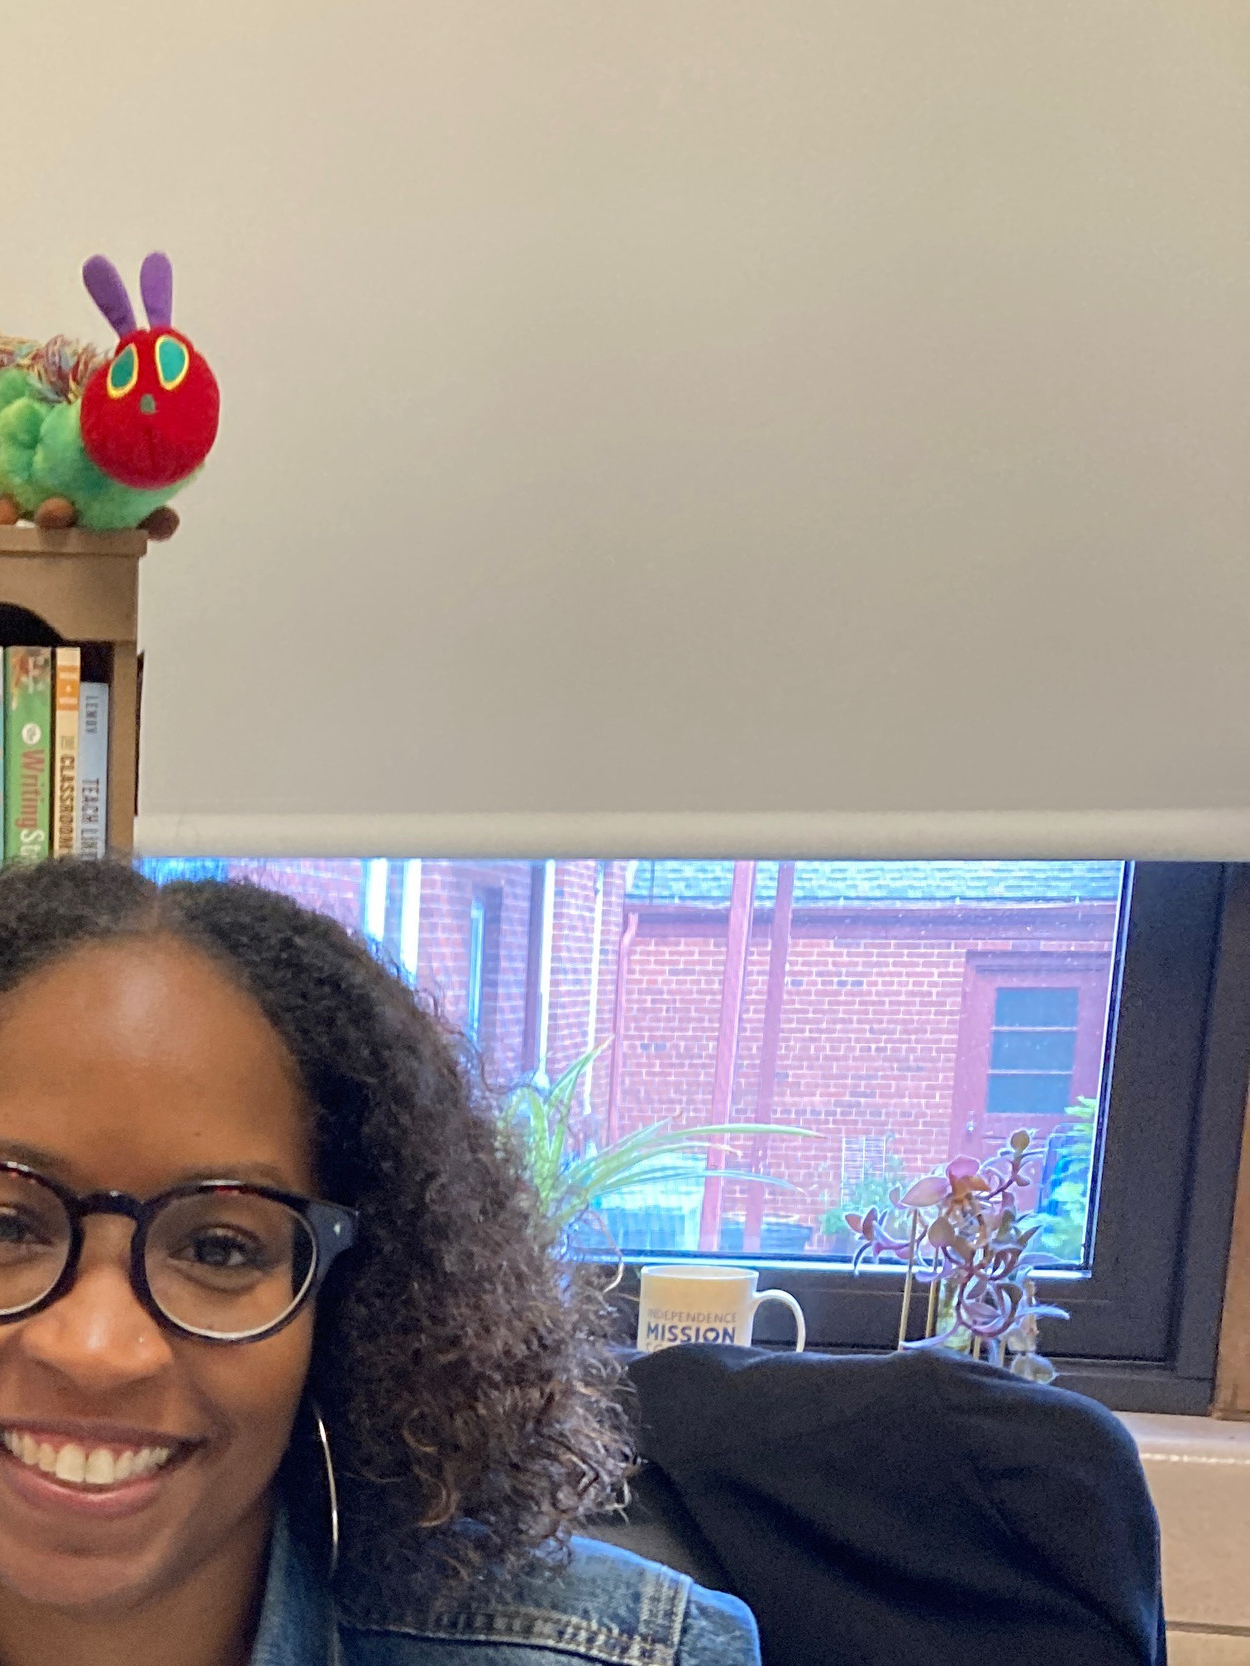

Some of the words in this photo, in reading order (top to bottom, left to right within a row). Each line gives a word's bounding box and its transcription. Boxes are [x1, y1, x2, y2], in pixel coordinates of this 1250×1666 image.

[15, 749, 46, 829] Writing
[58, 753, 75, 850] CLASSROOM
[81, 778, 100, 824] TEACH
[646, 1322, 737, 1343] MISSION
[647, 1308, 737, 1324] INDEPENDENCE
